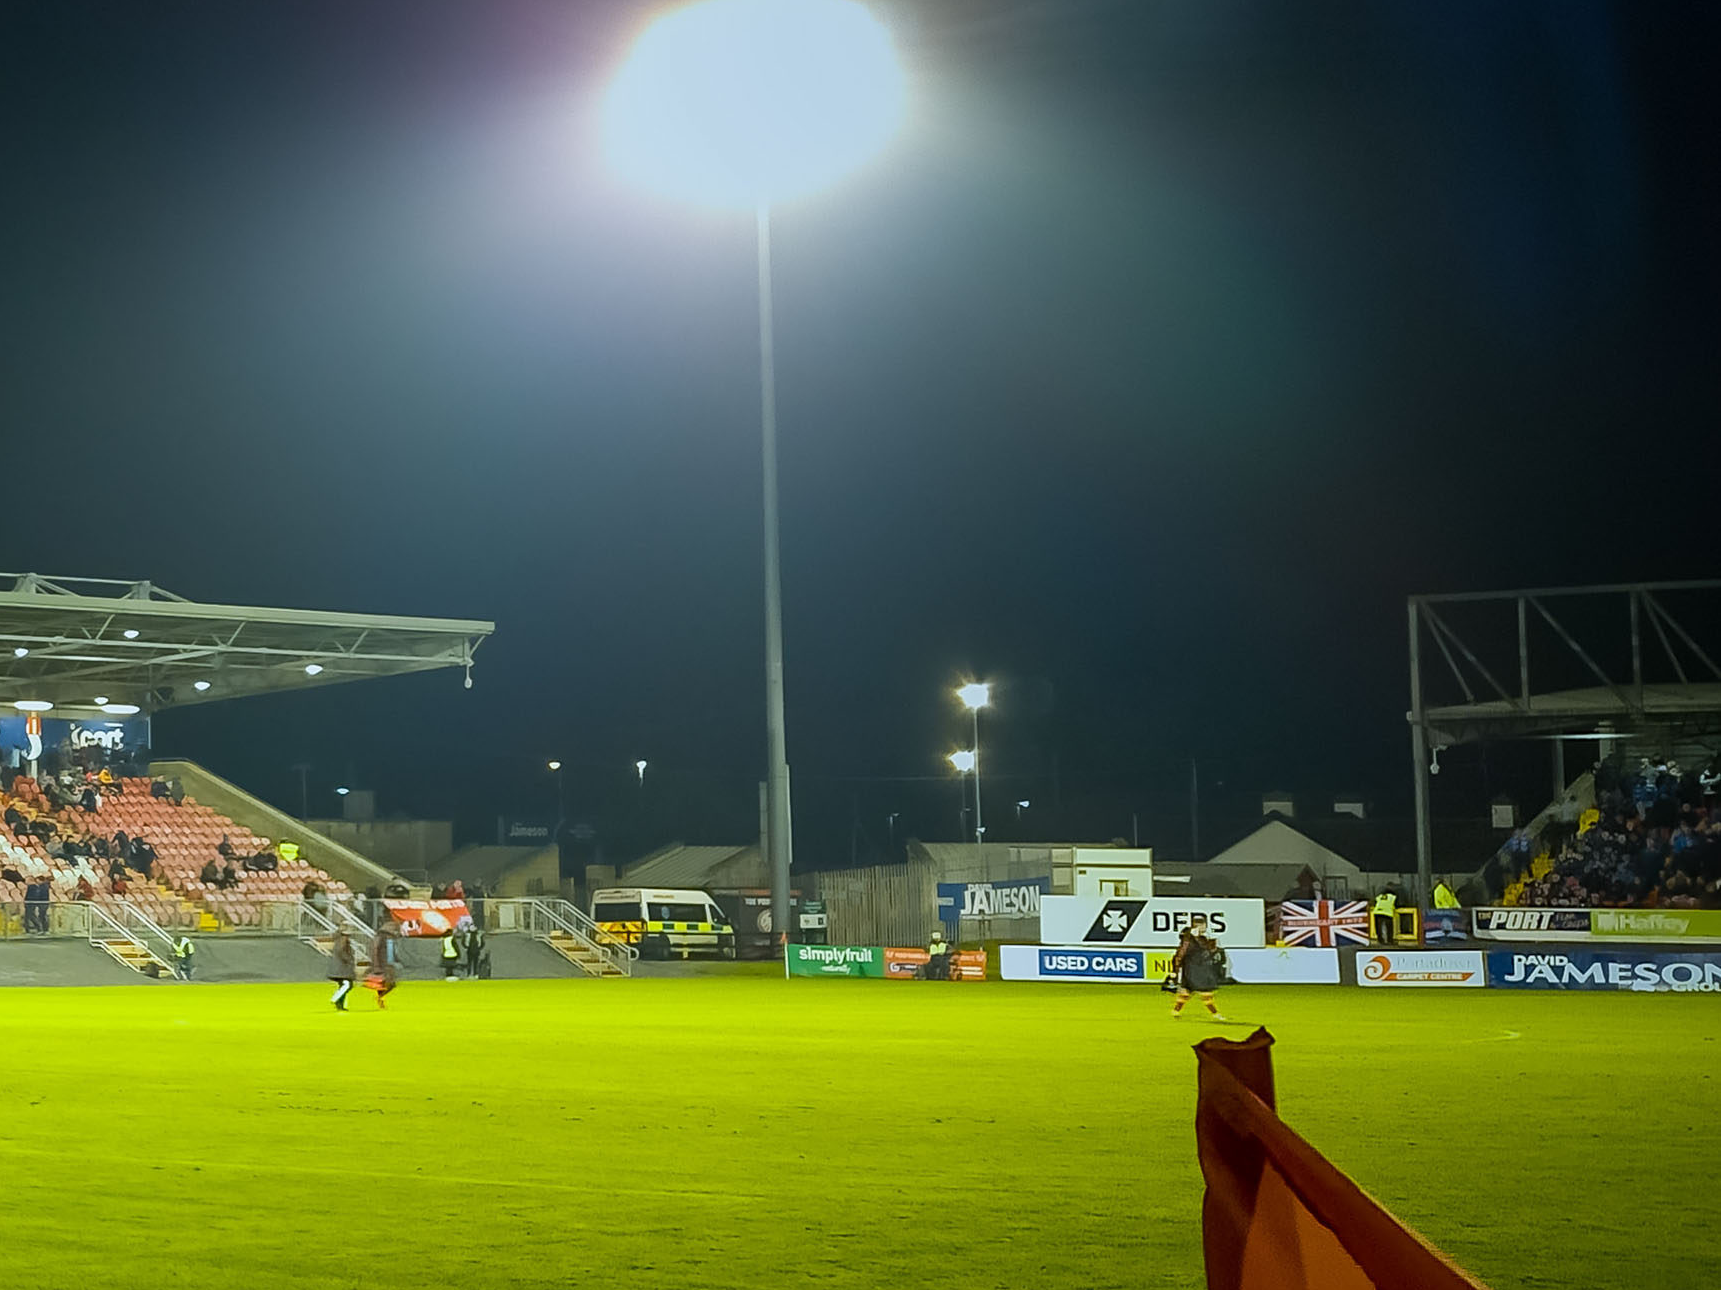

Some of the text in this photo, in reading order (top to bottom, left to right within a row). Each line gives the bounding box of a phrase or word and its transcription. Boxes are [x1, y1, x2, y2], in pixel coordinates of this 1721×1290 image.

[960, 885, 1040, 915] JAMESON
[1489, 911, 1555, 929] PORT
[1044, 955, 1089, 971] USED
[1091, 956, 1138, 973] CARS
[1513, 955, 1569, 967] DAVID
